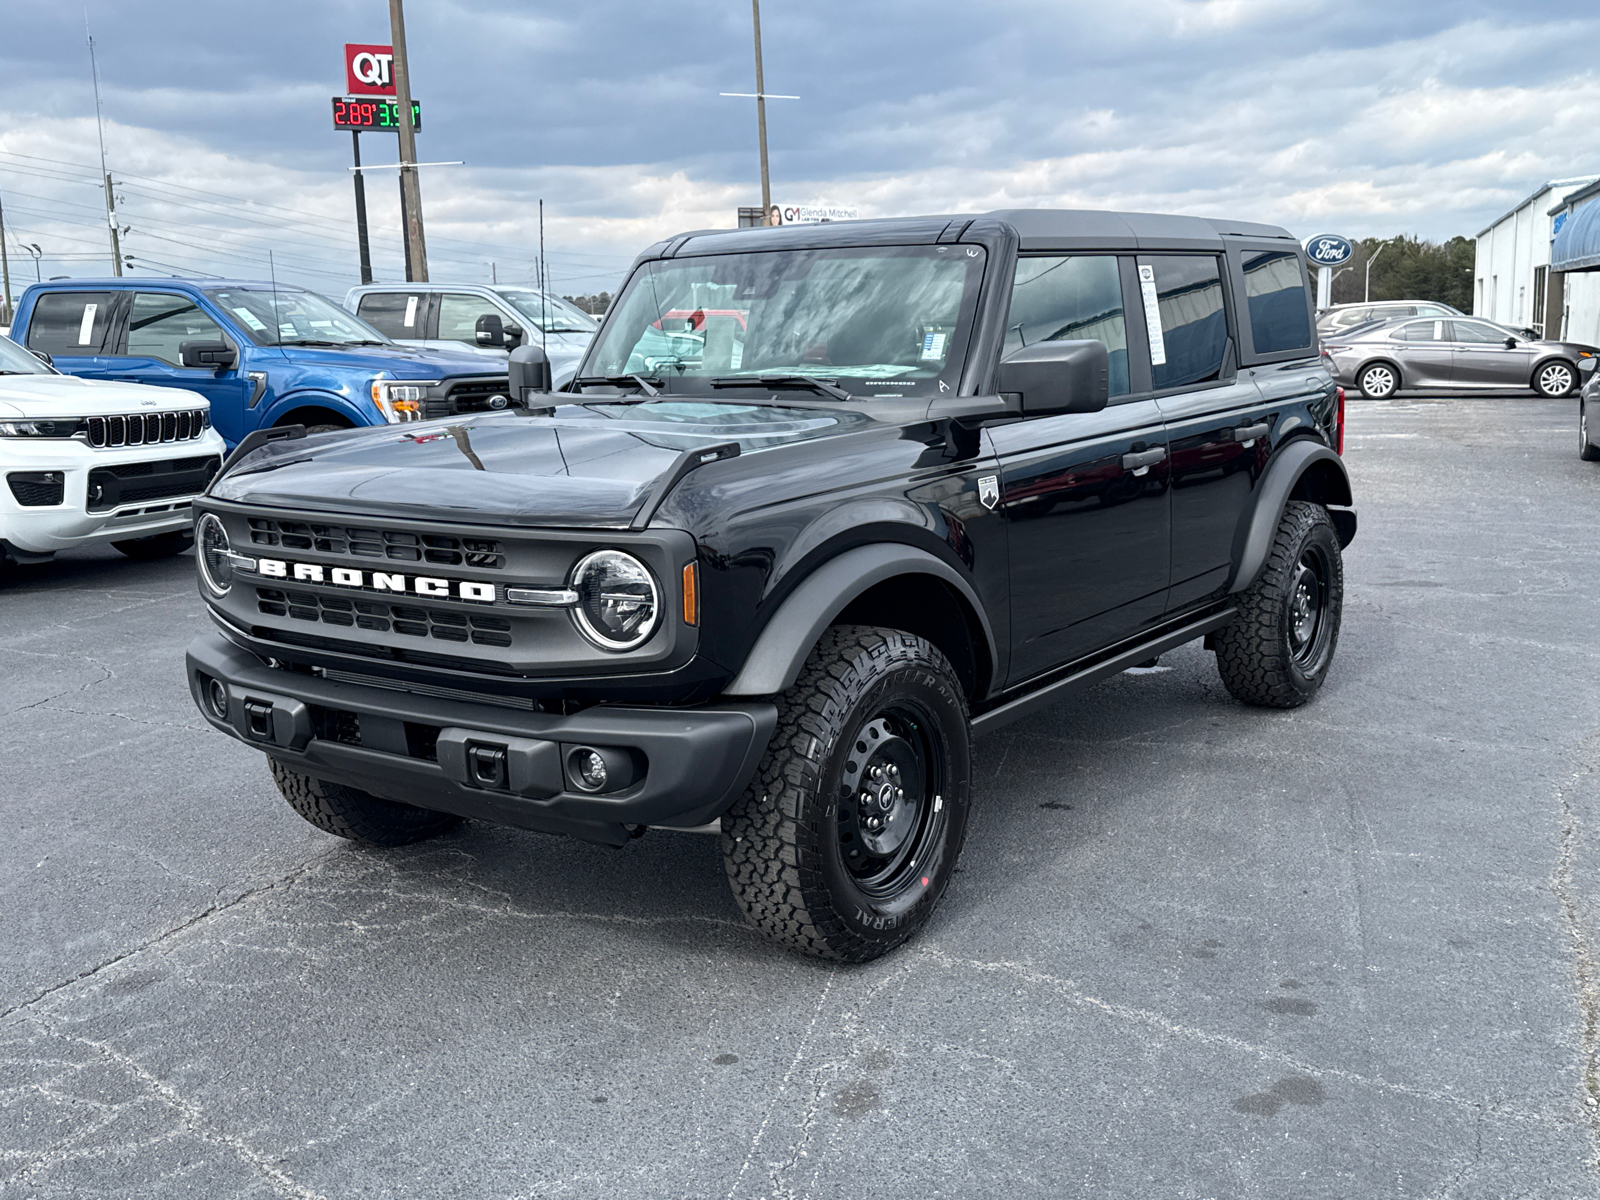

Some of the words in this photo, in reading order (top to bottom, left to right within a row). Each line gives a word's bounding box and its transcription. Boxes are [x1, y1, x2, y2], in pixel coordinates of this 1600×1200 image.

[352, 52, 393, 86] QT
[784, 207, 801, 222] GM
[800, 207, 828, 217] Glenda
[828, 208, 858, 219] Mitchell
[1315, 239, 1346, 260] Ford
[258, 558, 496, 602] BRONCO
